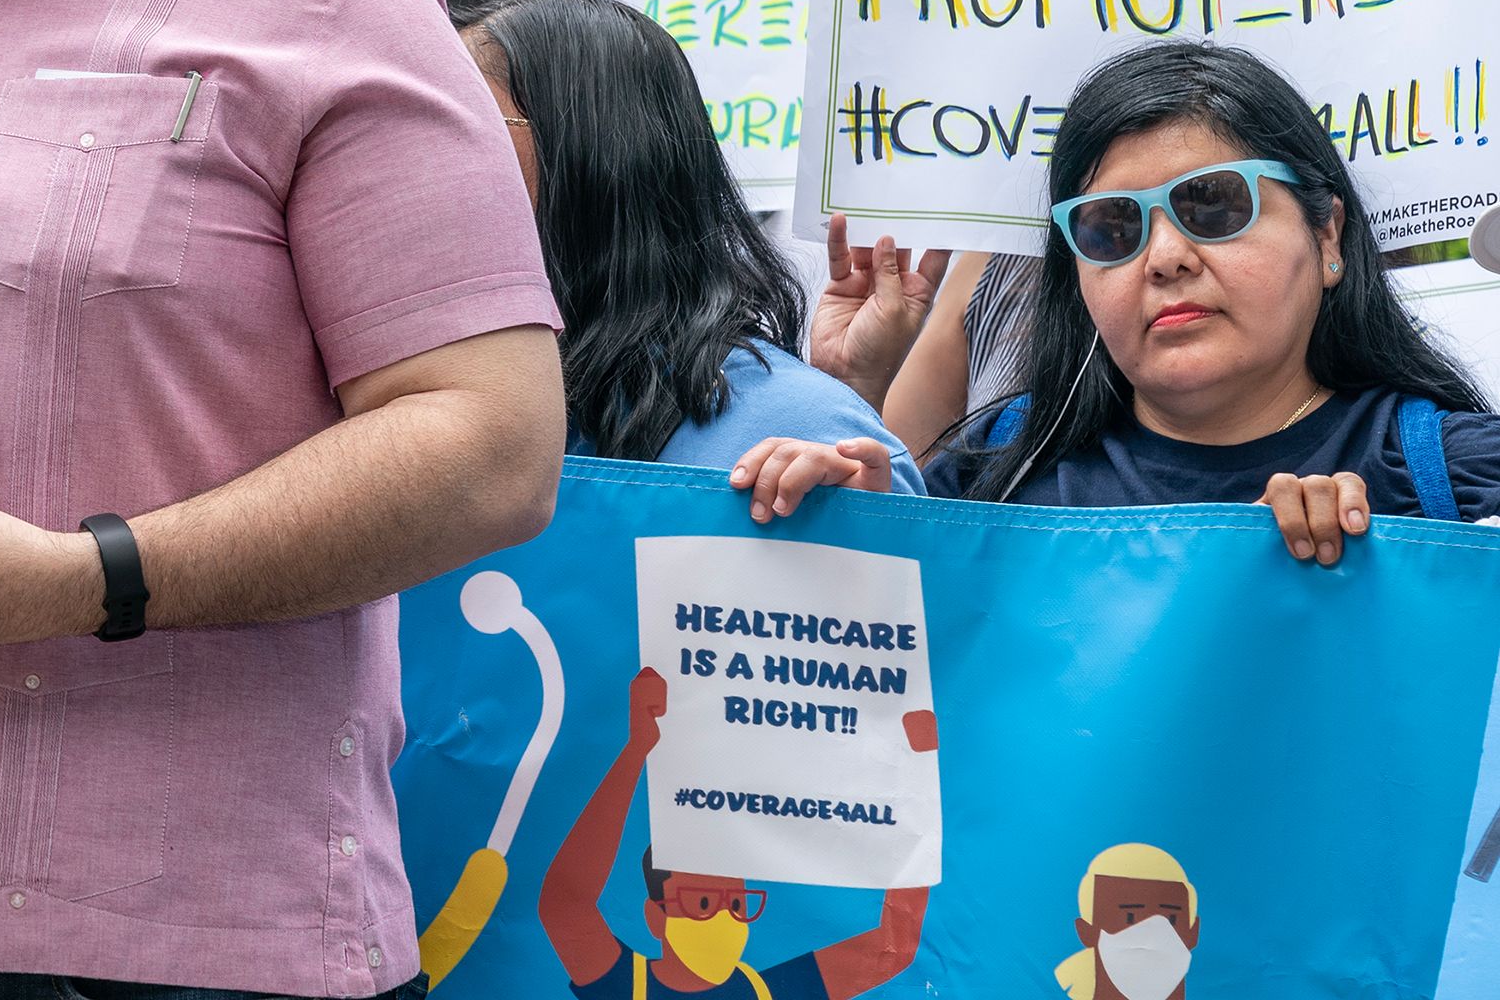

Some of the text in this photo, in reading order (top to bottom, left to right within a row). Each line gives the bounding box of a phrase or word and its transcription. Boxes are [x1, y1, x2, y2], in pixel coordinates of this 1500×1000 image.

[675, 603, 917, 651] HEALTHCARE
[680, 648, 907, 695] IS A HUMAN
[723, 695, 858, 735] RIGHT!!
[674, 787, 897, 825] #COVERAGE4ALL
